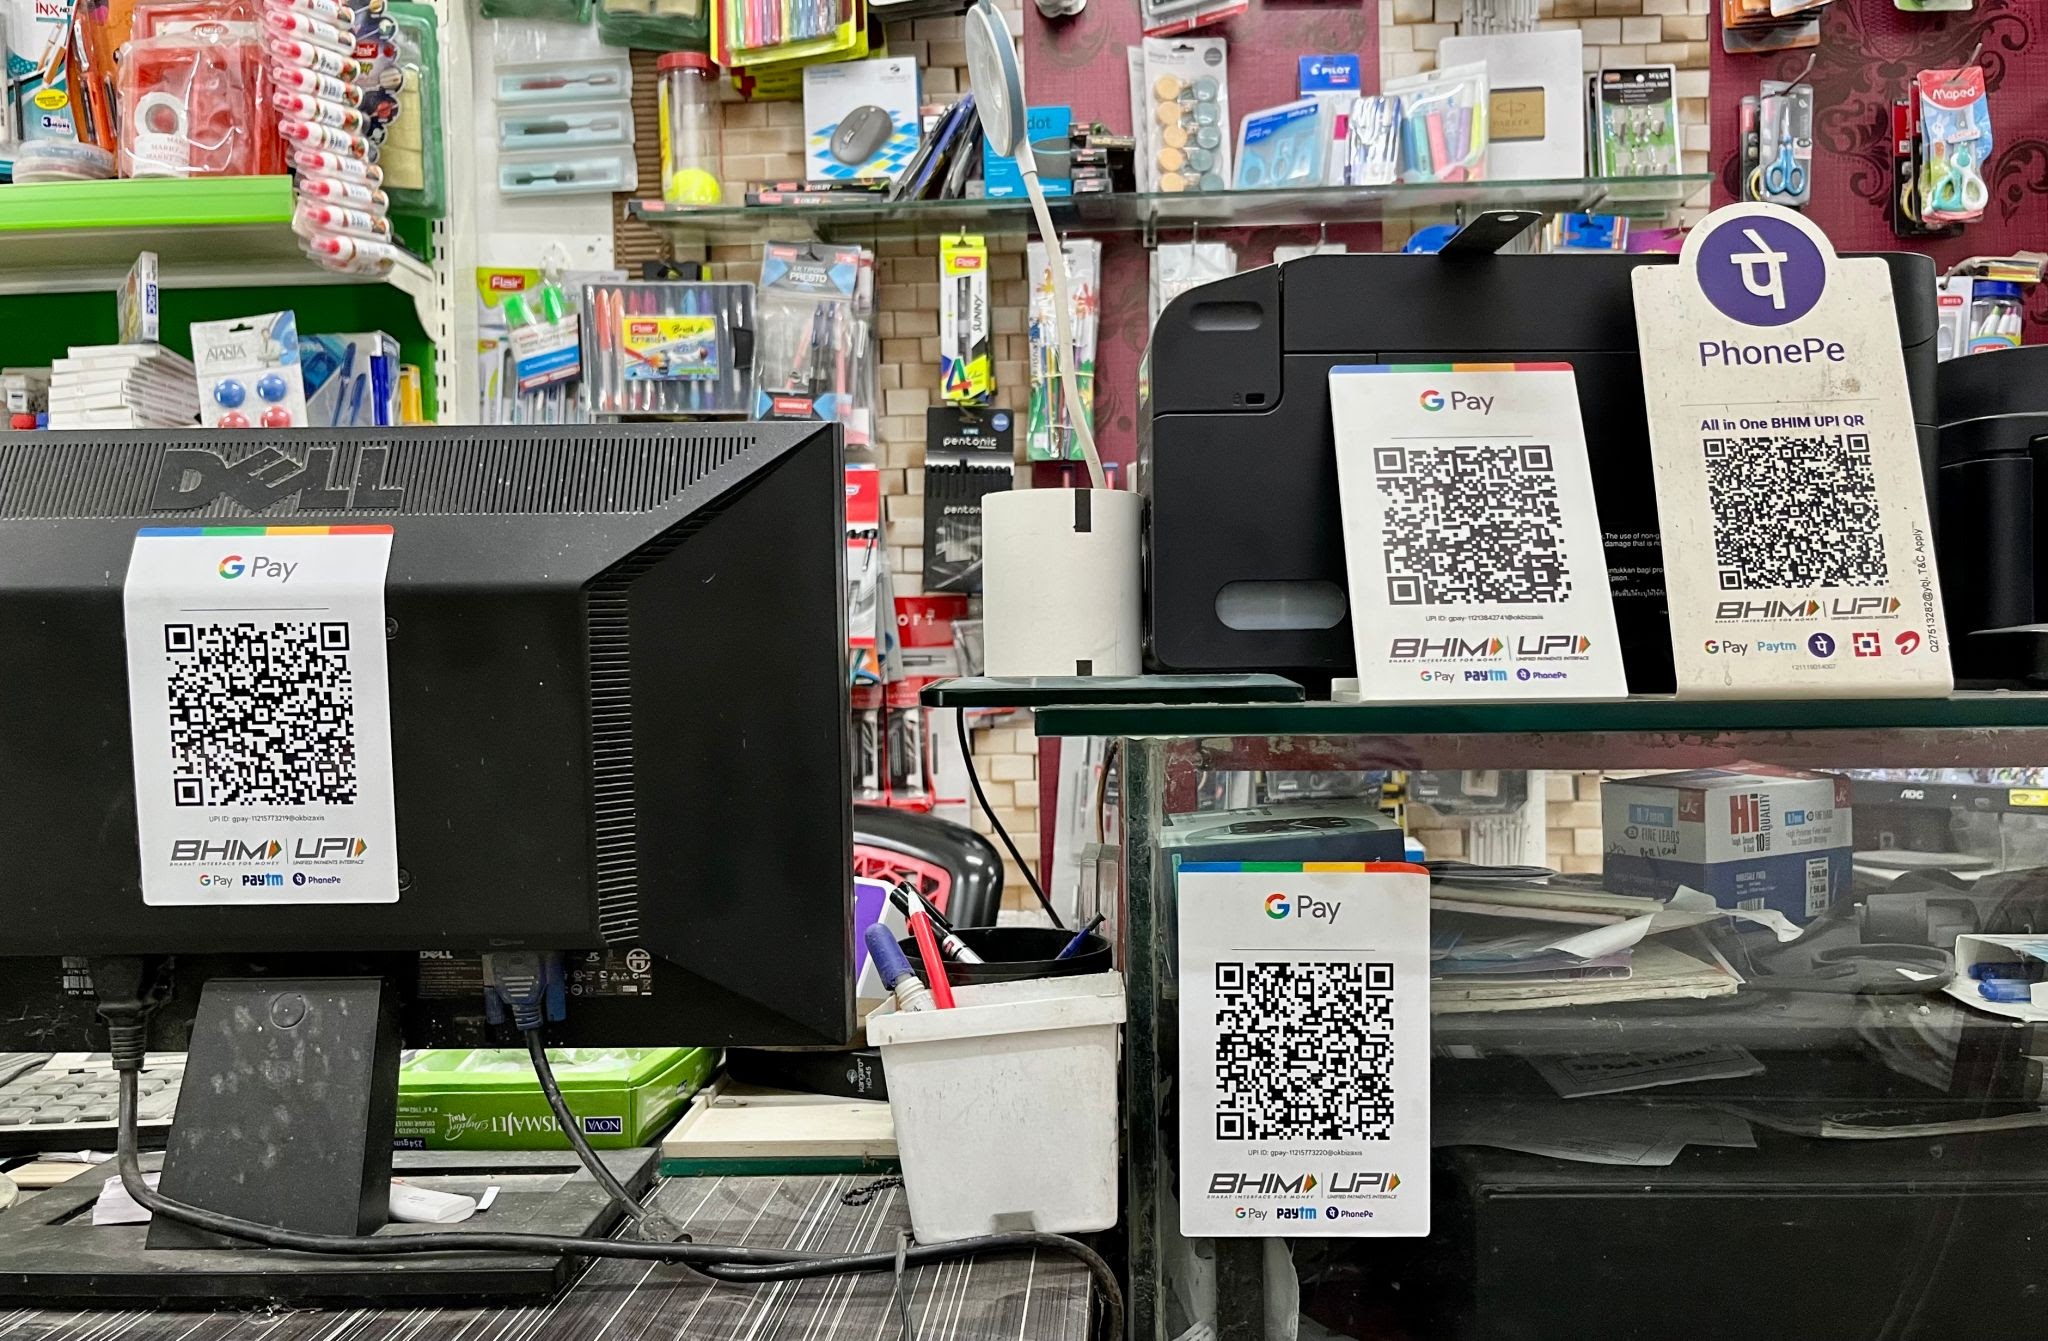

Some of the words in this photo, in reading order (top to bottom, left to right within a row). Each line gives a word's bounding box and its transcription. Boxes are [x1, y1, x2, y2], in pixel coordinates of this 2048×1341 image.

[1321, 66, 1351, 76] PILOT
[1932, 86, 1976, 101] Maped
[1729, 228, 1789, 310] पे
[491, 276, 523, 289] Flair
[972, 294, 985, 333] SUNNY
[1699, 337, 1846, 367] PhonePe
[1450, 391, 1495, 415] Pay
[1700, 418, 1720, 431] All
[1723, 418, 1736, 430] in
[1740, 416, 1768, 430] One
[1771, 416, 1811, 429] BHIM
[1814, 415, 1840, 428] UPI
[1843, 414, 1865, 428] QR
[943, 436, 998, 449] pentonic
[151, 446, 404, 515] DELL
[1604, 541, 1632, 549] damage
[1912, 528, 1925, 553] Apply
[250, 556, 299, 583] Pay
[1715, 600, 1808, 619] BHIM
[1832, 597, 1889, 615] UPI
[1389, 637, 1490, 658] BHIM
[1517, 635, 1579, 655] UPI
[1722, 640, 1748, 656] Pay
[1757, 641, 1797, 653] Paytm
[1434, 671, 1455, 683] Pay
[1532, 671, 1568, 680] PhonePe
[1900, 789, 1925, 800] AOC
[209, 815, 221, 823] UPI
[1729, 793, 1760, 835] Hi
[1759, 793, 1771, 832] QUALITY
[1641, 827, 1657, 842] FINE
[1658, 829, 1680, 845] LEADS
[170, 839, 271, 861] BHIM
[294, 837, 356, 858] UPI
[213, 875, 233, 888] Pay
[307, 875, 342, 884] PhonePe
[1297, 894, 1341, 925] Pay
[419, 950, 454, 960] DELL
[856, 1060, 867, 1094] kangaro
[865, 1066, 873, 1089] HD-45
[587, 1119, 620, 1132] NOVA
[1208, 1173, 1304, 1194] BHIM
[1329, 1172, 1390, 1193] UPI
[1248, 1208, 1268, 1221] Pay
[1341, 1210, 1374, 1219] PhonePe
